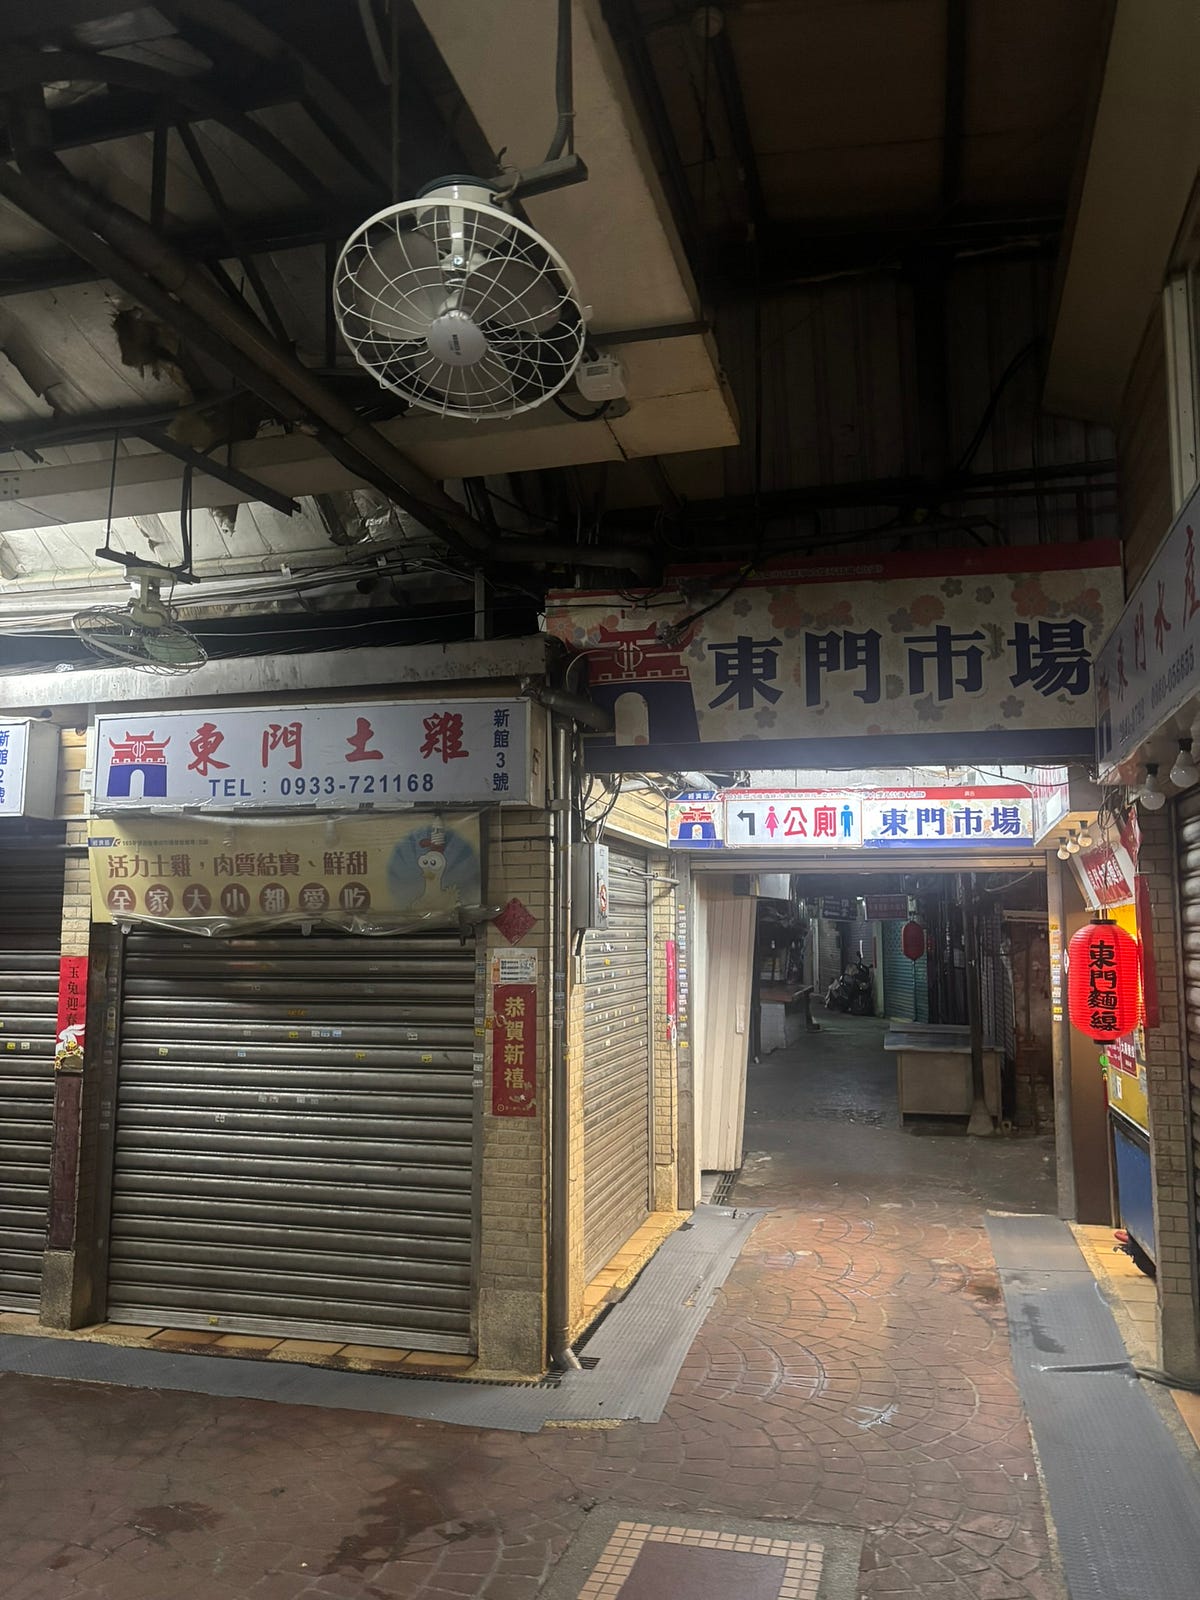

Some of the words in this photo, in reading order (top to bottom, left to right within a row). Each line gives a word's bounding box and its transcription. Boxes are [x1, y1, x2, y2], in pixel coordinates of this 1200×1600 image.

[707, 619, 1093, 710] 東門市場
[187, 711, 470, 776] 東門土雞
[491, 708, 510, 792] 新館3號
[280, 773, 434, 796] 0933-721168
[783, 805, 838, 838] 公廁
[880, 806, 1022, 837] 東門市場
[110, 886, 367, 915] 全家大小都愛吃
[66, 966, 80, 1027] 玉兔迎春
[1087, 940, 1121, 1032] 東門麵線
[503, 996, 525, 1089] 恭賀新禧
